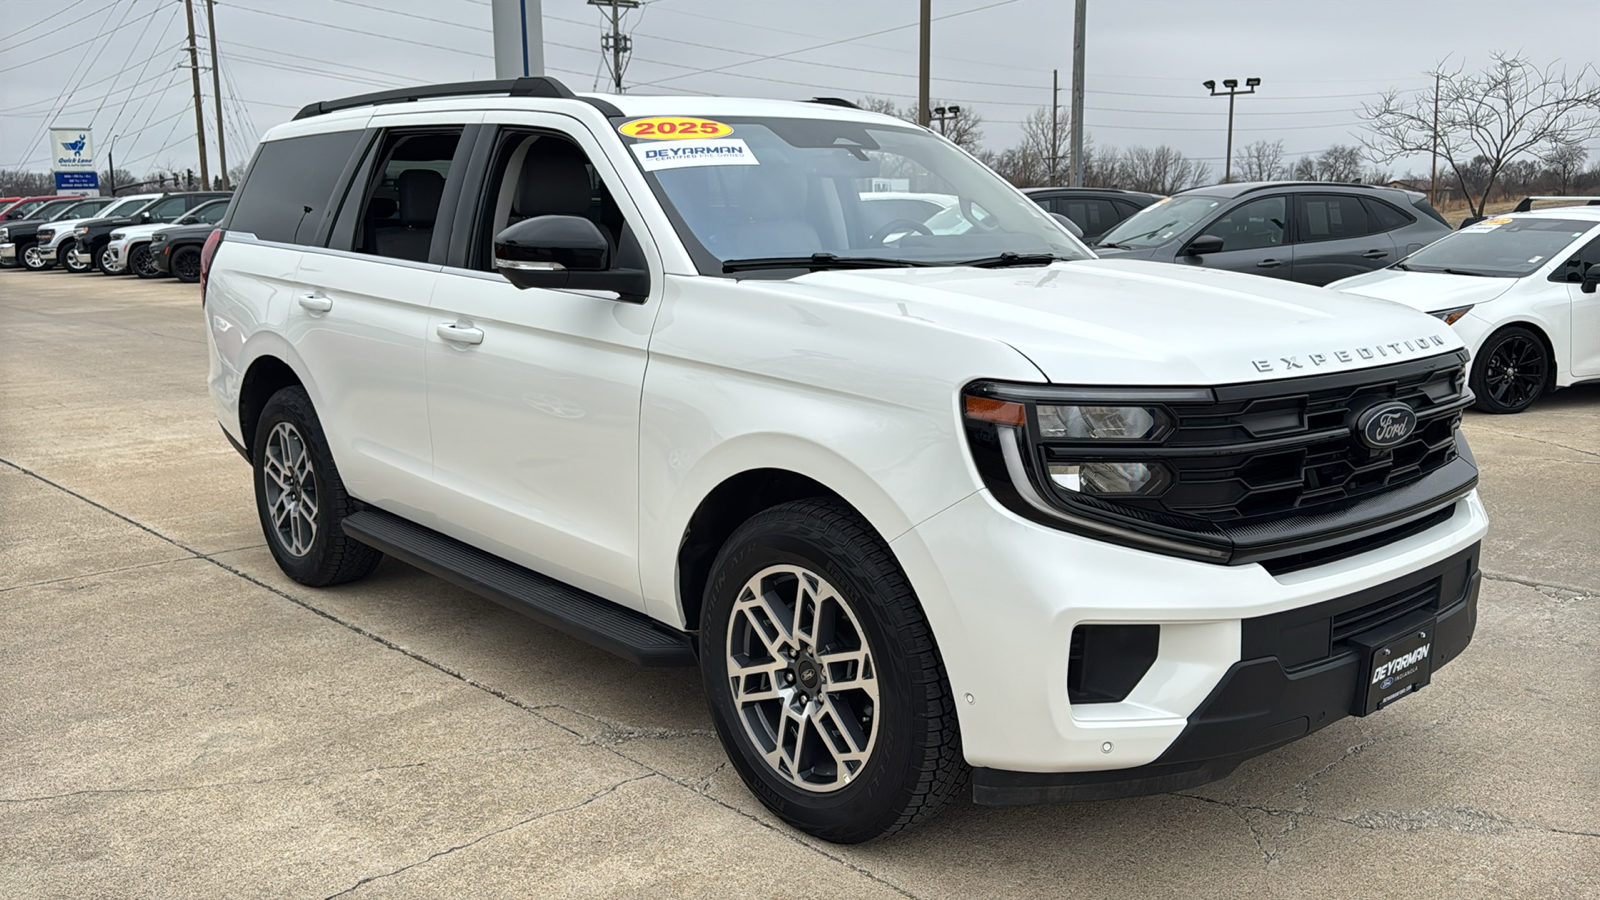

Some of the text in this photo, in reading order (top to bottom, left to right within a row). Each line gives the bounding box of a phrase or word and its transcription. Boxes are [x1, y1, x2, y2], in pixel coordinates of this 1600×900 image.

[635, 122, 720, 135] 2025
[645, 146, 743, 159] DEYARMAN
[1252, 335, 1445, 372] EXPEDITION
[1376, 413, 1408, 441] Ford
[1372, 643, 1430, 684] DEYARMAN
[1395, 666, 1418, 681] INDIANOLA
